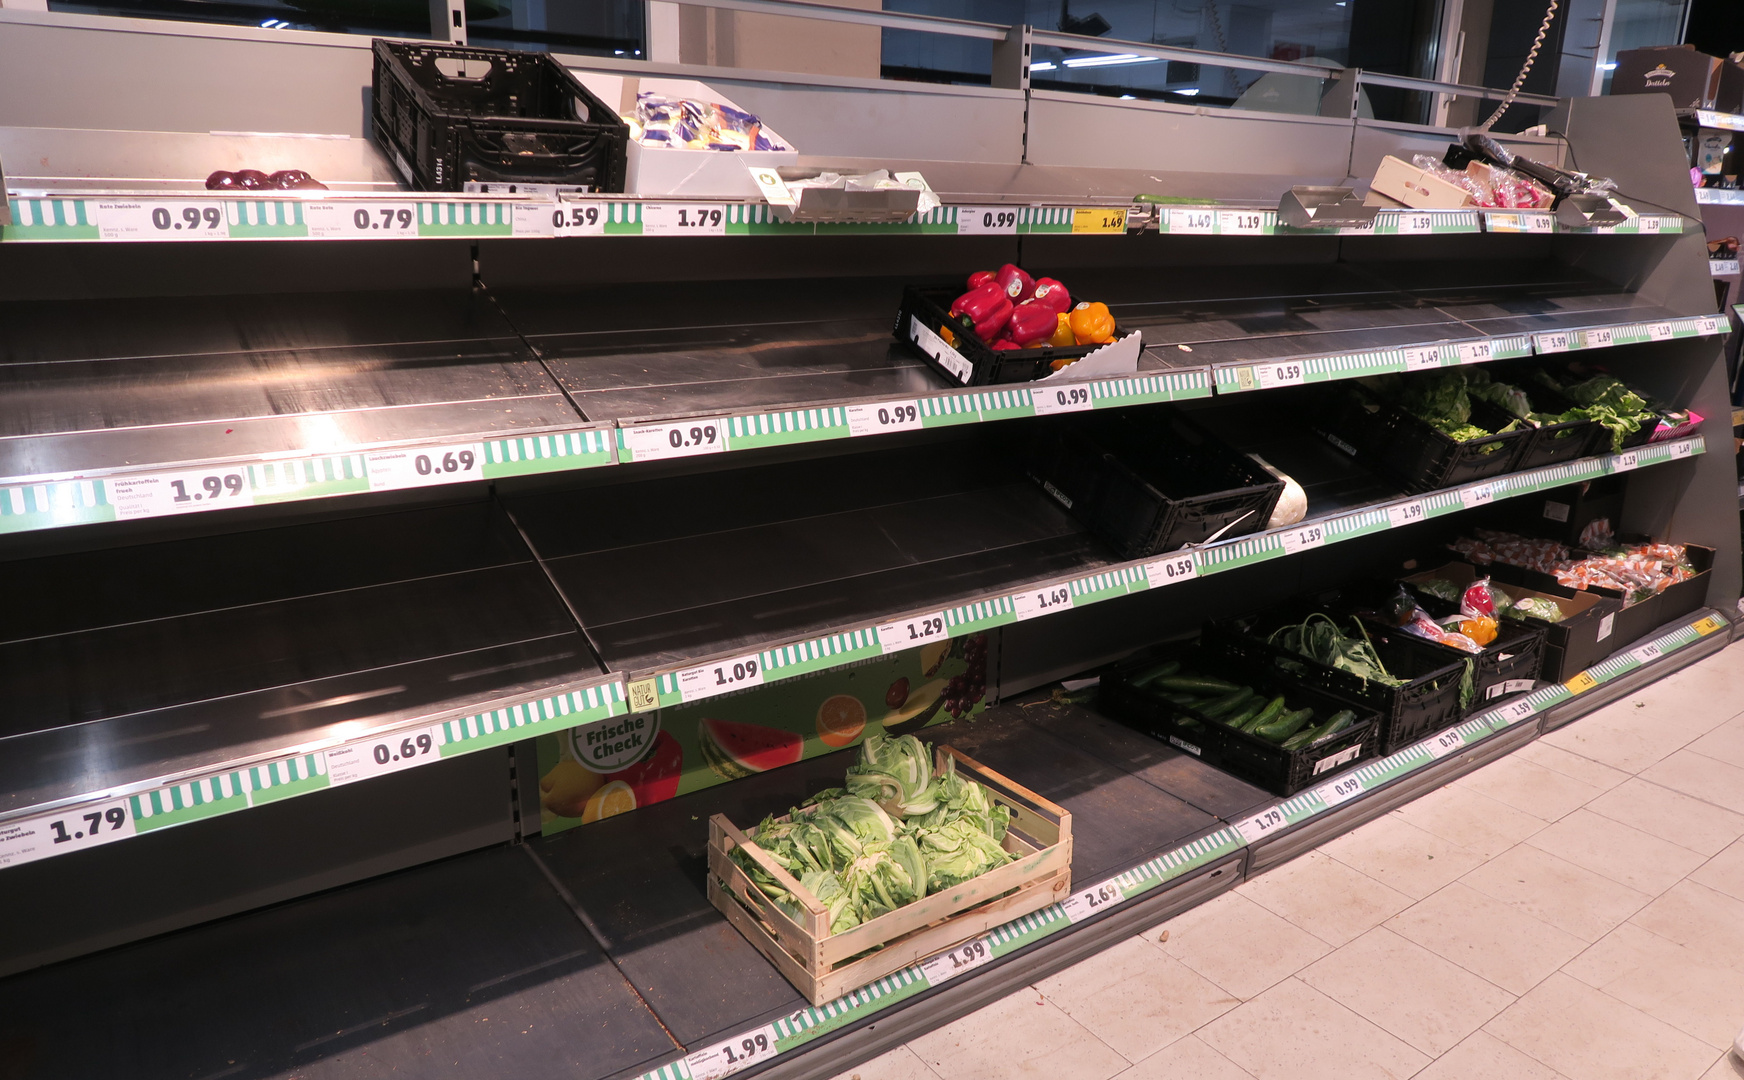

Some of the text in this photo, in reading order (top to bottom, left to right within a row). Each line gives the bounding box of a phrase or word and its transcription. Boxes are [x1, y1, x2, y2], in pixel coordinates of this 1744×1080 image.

[1645, 79, 1671, 87] Datteln
[152, 207, 221, 230] 0.99
[353, 208, 412, 230] 0.79
[552, 207, 599, 228] 0.59
[678, 209, 722, 227] 1.79
[983, 211, 1015, 228] 0.99
[1102, 217, 1123, 228] 1.49
[1187, 214, 1211, 228] 1.49
[1237, 215, 1259, 229] 1.19
[1413, 217, 1430, 229] 1.59
[1536, 218, 1549, 228] 0.99
[1597, 331, 1611, 343] 1.69
[1658, 325, 1671, 336] 1.19
[1550, 336, 1566, 348] 3.99
[1419, 350, 1438, 364] 1.49
[1471, 345, 1490, 357] 1.79
[1276, 365, 1300, 380] 0.59
[1056, 388, 1088, 406] 0.99
[878, 405, 917, 425] 0.99
[669, 425, 717, 448] 0.99
[415, 450, 475, 476] 0.69
[1624, 455, 1637, 466] 1.19
[115, 478, 160, 488] Frühkartoffeln
[171, 474, 243, 503] 1.99
[1475, 487, 1491, 501] 1.49
[1402, 504, 1421, 519] 1.99
[1299, 528, 1321, 545] 1.39
[1166, 559, 1192, 577] 0.59
[1037, 588, 1068, 608] 1.49
[907, 617, 943, 640] 1.29
[714, 660, 757, 685] 1.09
[632, 683, 651, 698] NATUR
[634, 694, 646, 707] GUT
[1511, 702, 1532, 716] 1.59
[587, 717, 645, 747] Frische
[1438, 732, 1460, 748] 0.79
[373, 733, 432, 766] 0.69
[593, 733, 643, 761] Check
[1334, 778, 1360, 796] 0.99
[50, 807, 126, 845] 1.79
[1254, 810, 1282, 831] 1.79
[6, 830, 36, 841] Zwiebeln
[1084, 884, 1118, 908] 2.69
[947, 942, 986, 969] 1.99
[722, 1034, 769, 1065] 1.99
